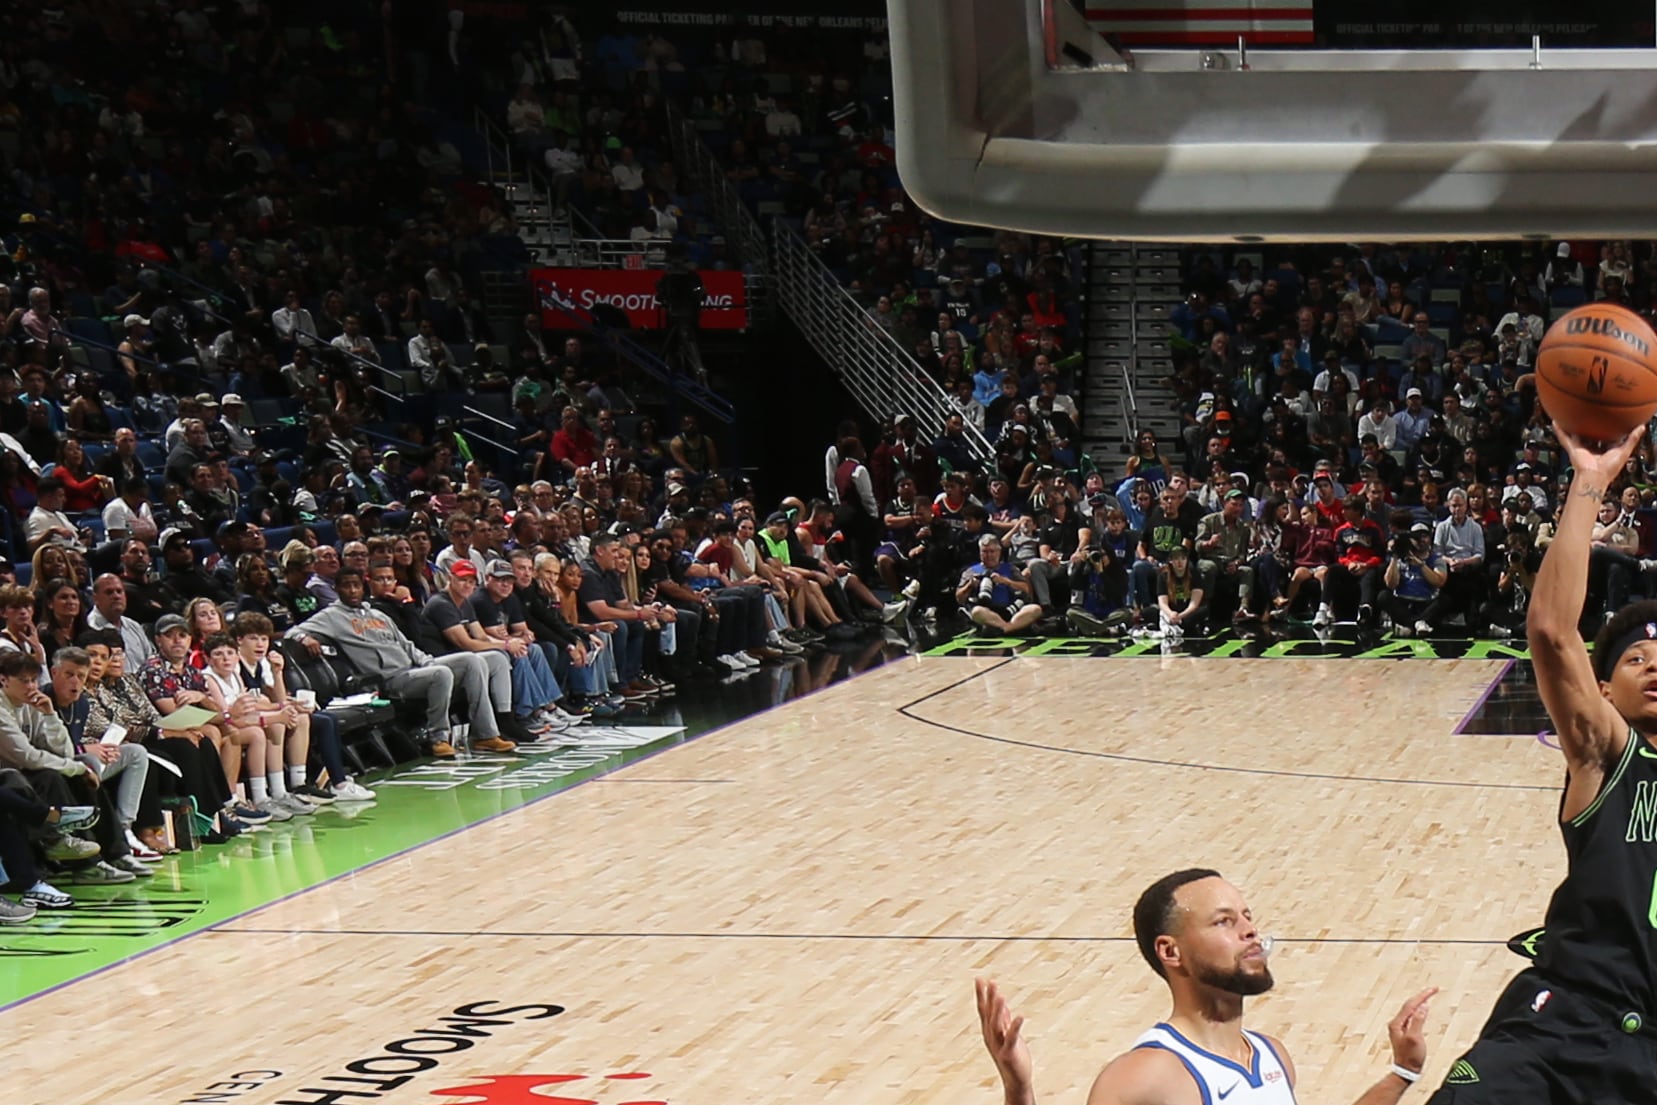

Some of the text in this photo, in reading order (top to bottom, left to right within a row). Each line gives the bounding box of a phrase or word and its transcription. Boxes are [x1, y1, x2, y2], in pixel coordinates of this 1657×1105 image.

[617, 11, 660, 23] OFFICIAL
[662, 12, 713, 25] TICKETING
[819, 16, 863, 28] ORLEANS
[1336, 23, 1375, 34] OFFICIAL
